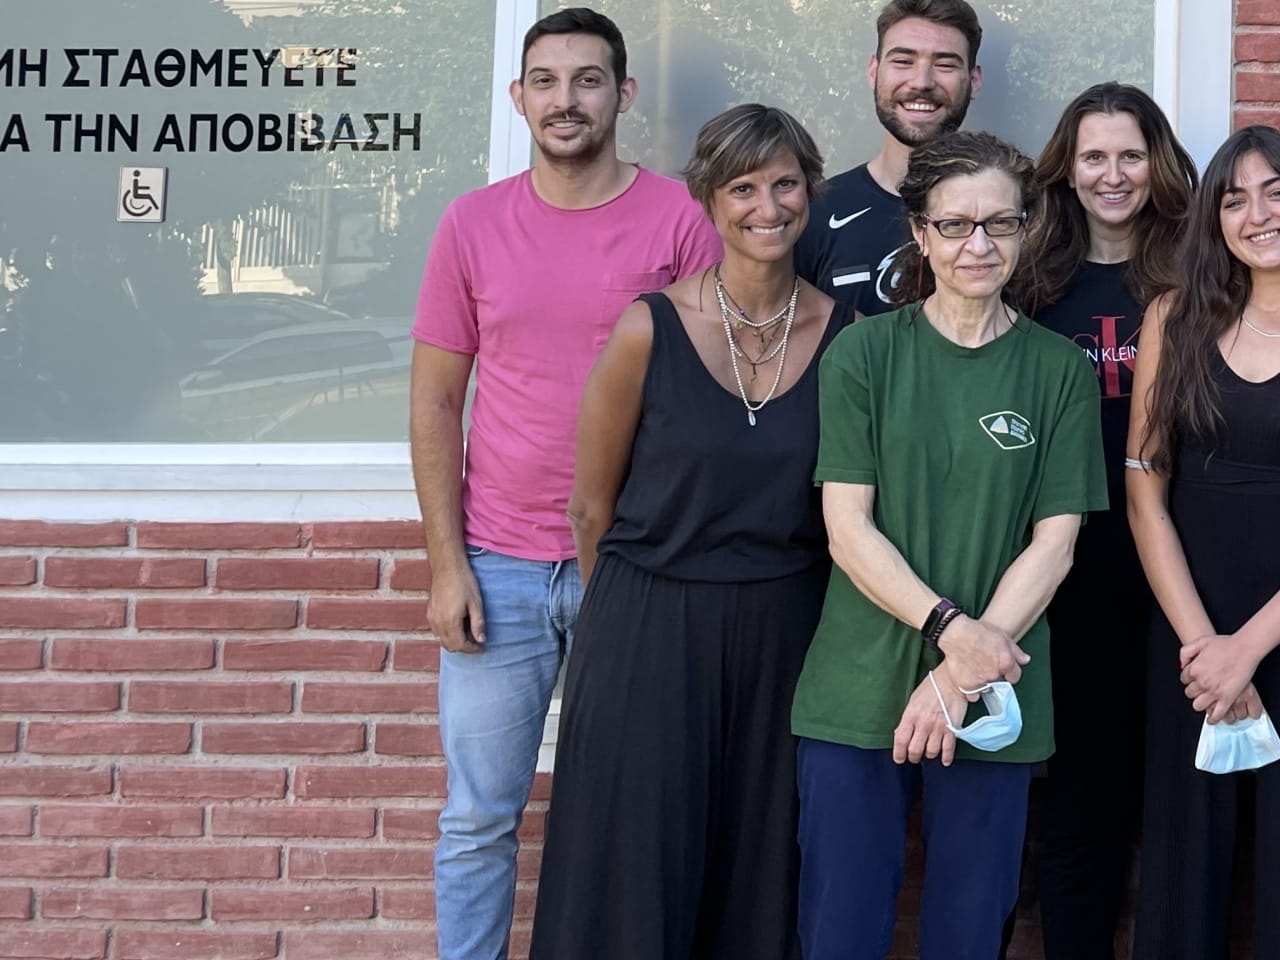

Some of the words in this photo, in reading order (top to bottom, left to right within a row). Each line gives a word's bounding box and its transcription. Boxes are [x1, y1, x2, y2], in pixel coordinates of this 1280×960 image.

[62, 48, 358, 87] ΣΤΑΘΜΕΥΕΤΕ
[45, 113, 139, 152] ΤΗΝ
[153, 113, 422, 152] ΑΠΟΒΙΒΑΣΗ
